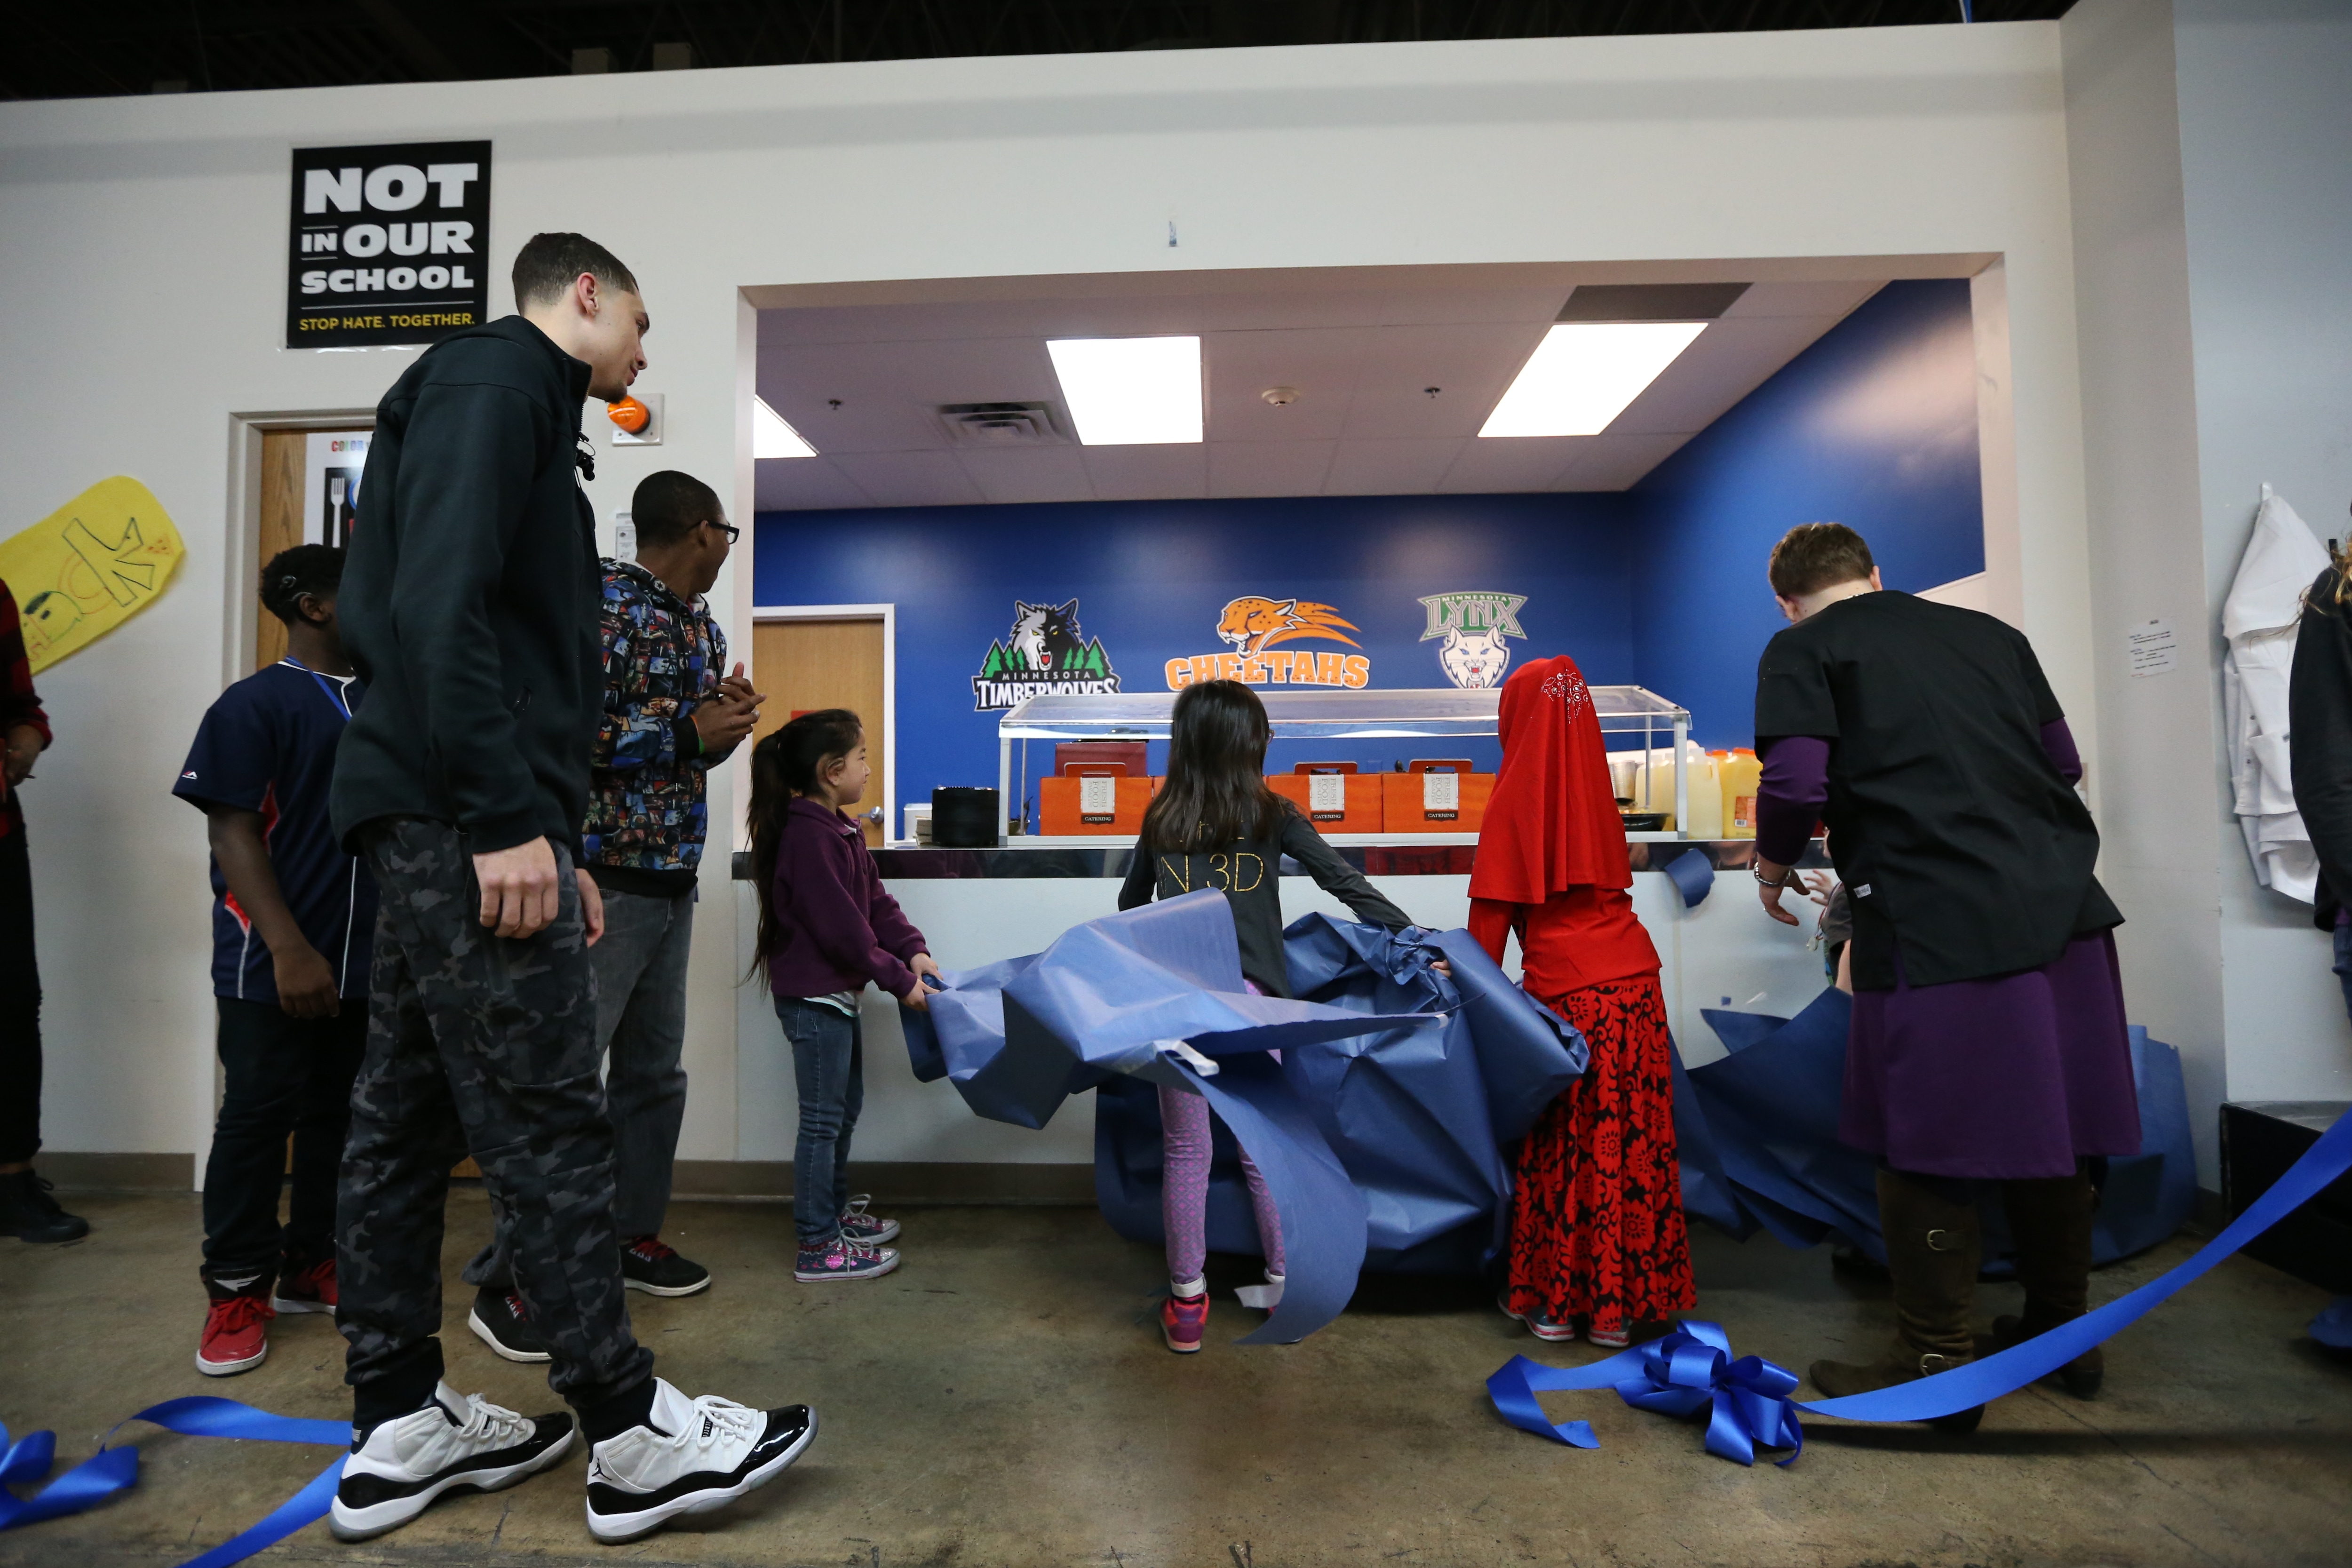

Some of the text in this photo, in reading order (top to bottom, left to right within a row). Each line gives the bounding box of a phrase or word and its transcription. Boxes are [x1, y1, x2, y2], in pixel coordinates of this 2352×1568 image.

[304, 163, 478, 214] NOT
[301, 221, 474, 257] IN OUR
[301, 266, 474, 294] SCHOOL
[300, 312, 475, 331] STOP HATE. TOGETHER.
[1426, 597, 1522, 636] LYNX
[1002, 671, 1091, 681] MINNESOTA
[1165, 651, 1370, 692] CHEETAHS
[1206, 852, 1263, 892] 3D
